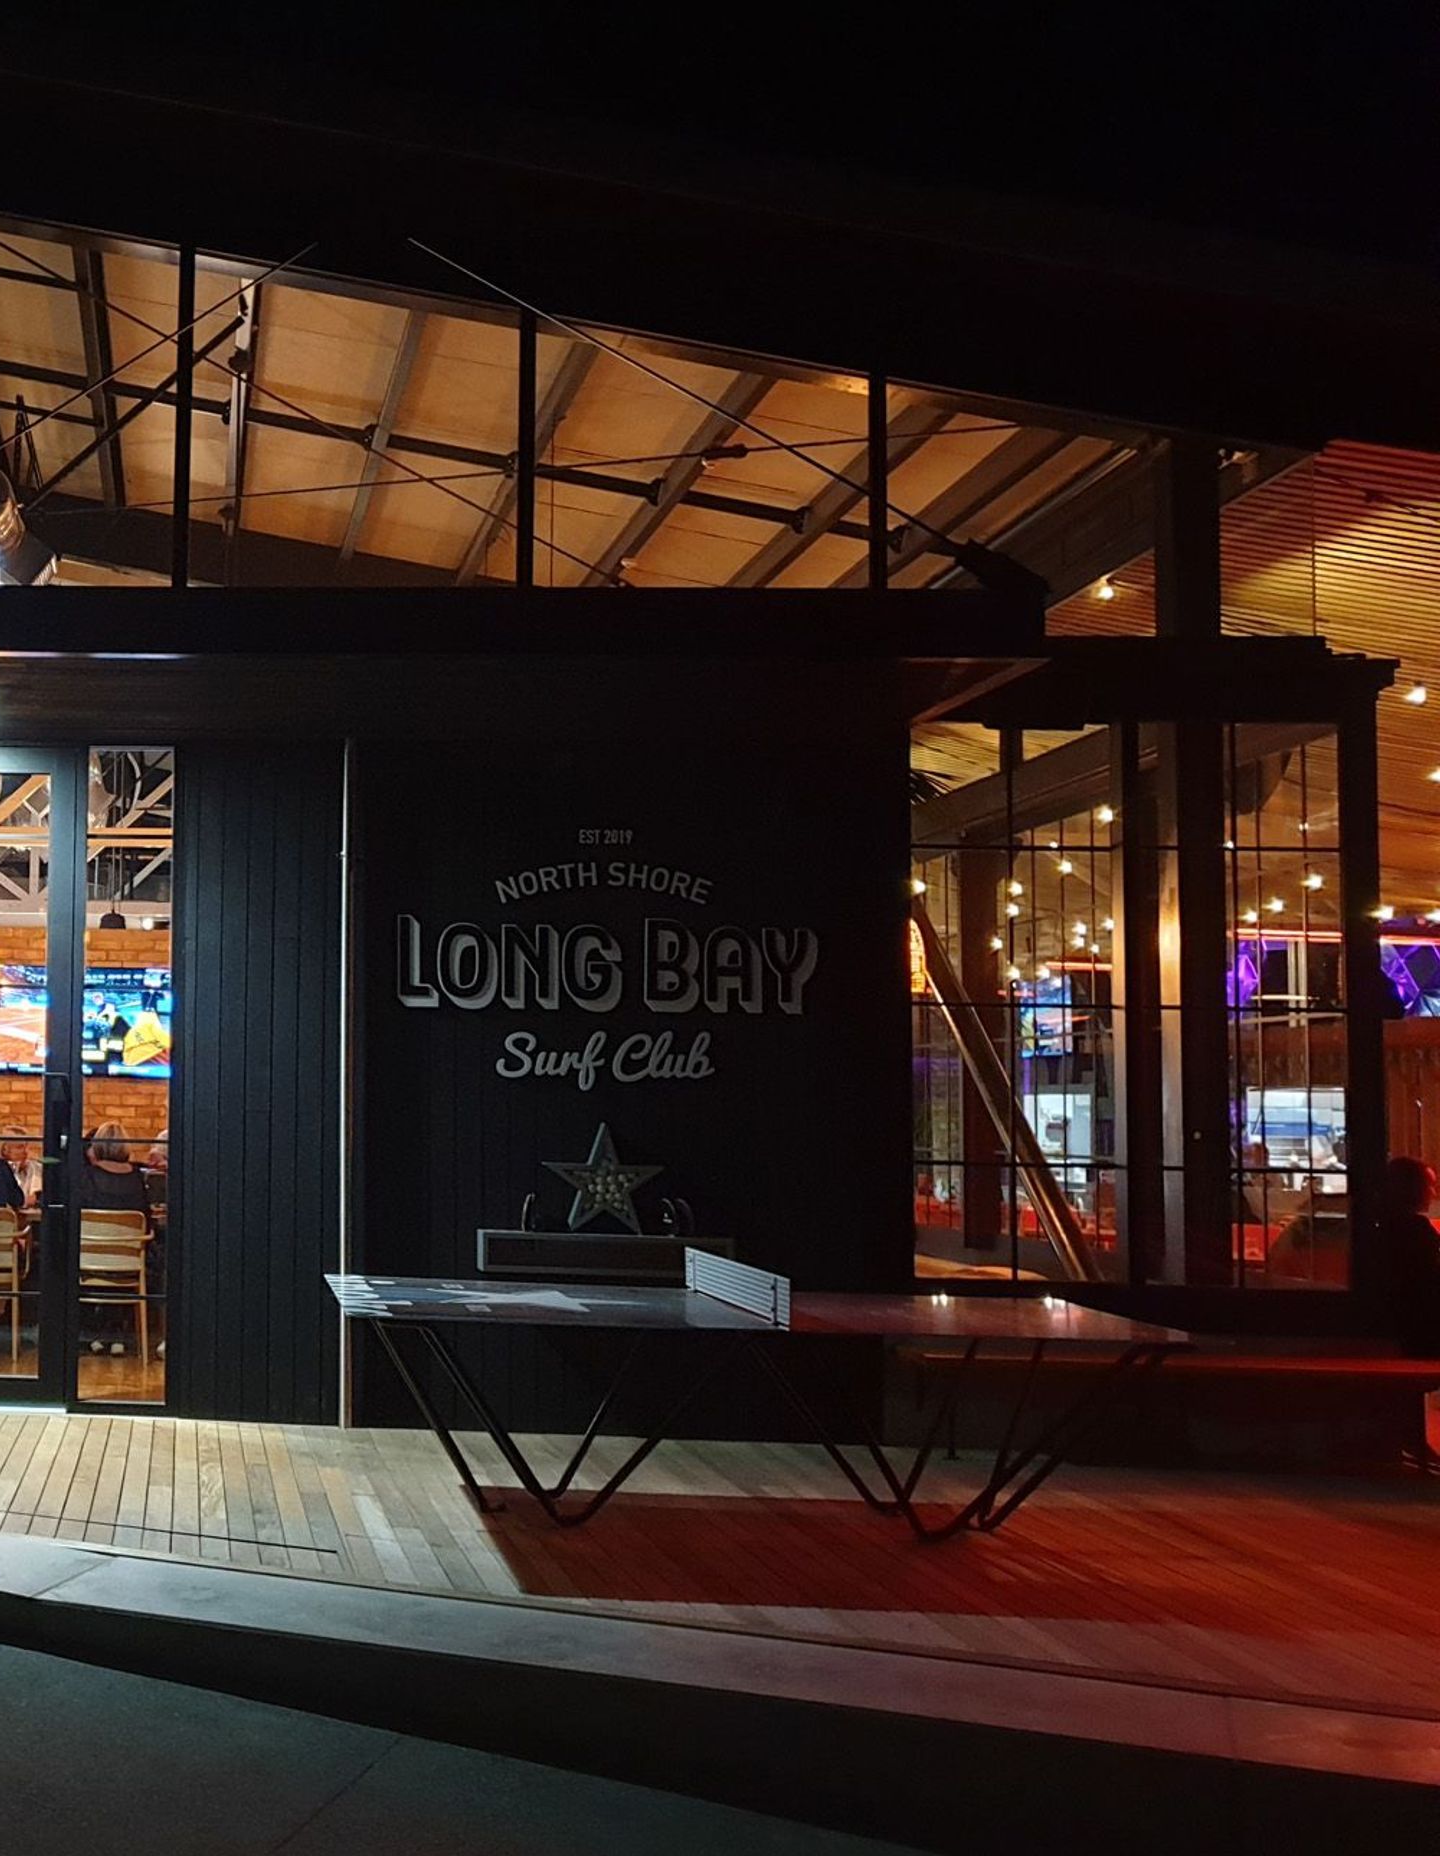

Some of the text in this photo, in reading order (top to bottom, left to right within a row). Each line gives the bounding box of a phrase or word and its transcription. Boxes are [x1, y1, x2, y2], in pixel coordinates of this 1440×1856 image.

[578, 829, 633, 845] EST 2019
[495, 862, 714, 905] NORTH SHORE
[397, 914, 819, 1015] LONG BAY
[495, 1031, 716, 1092] Surf Club
